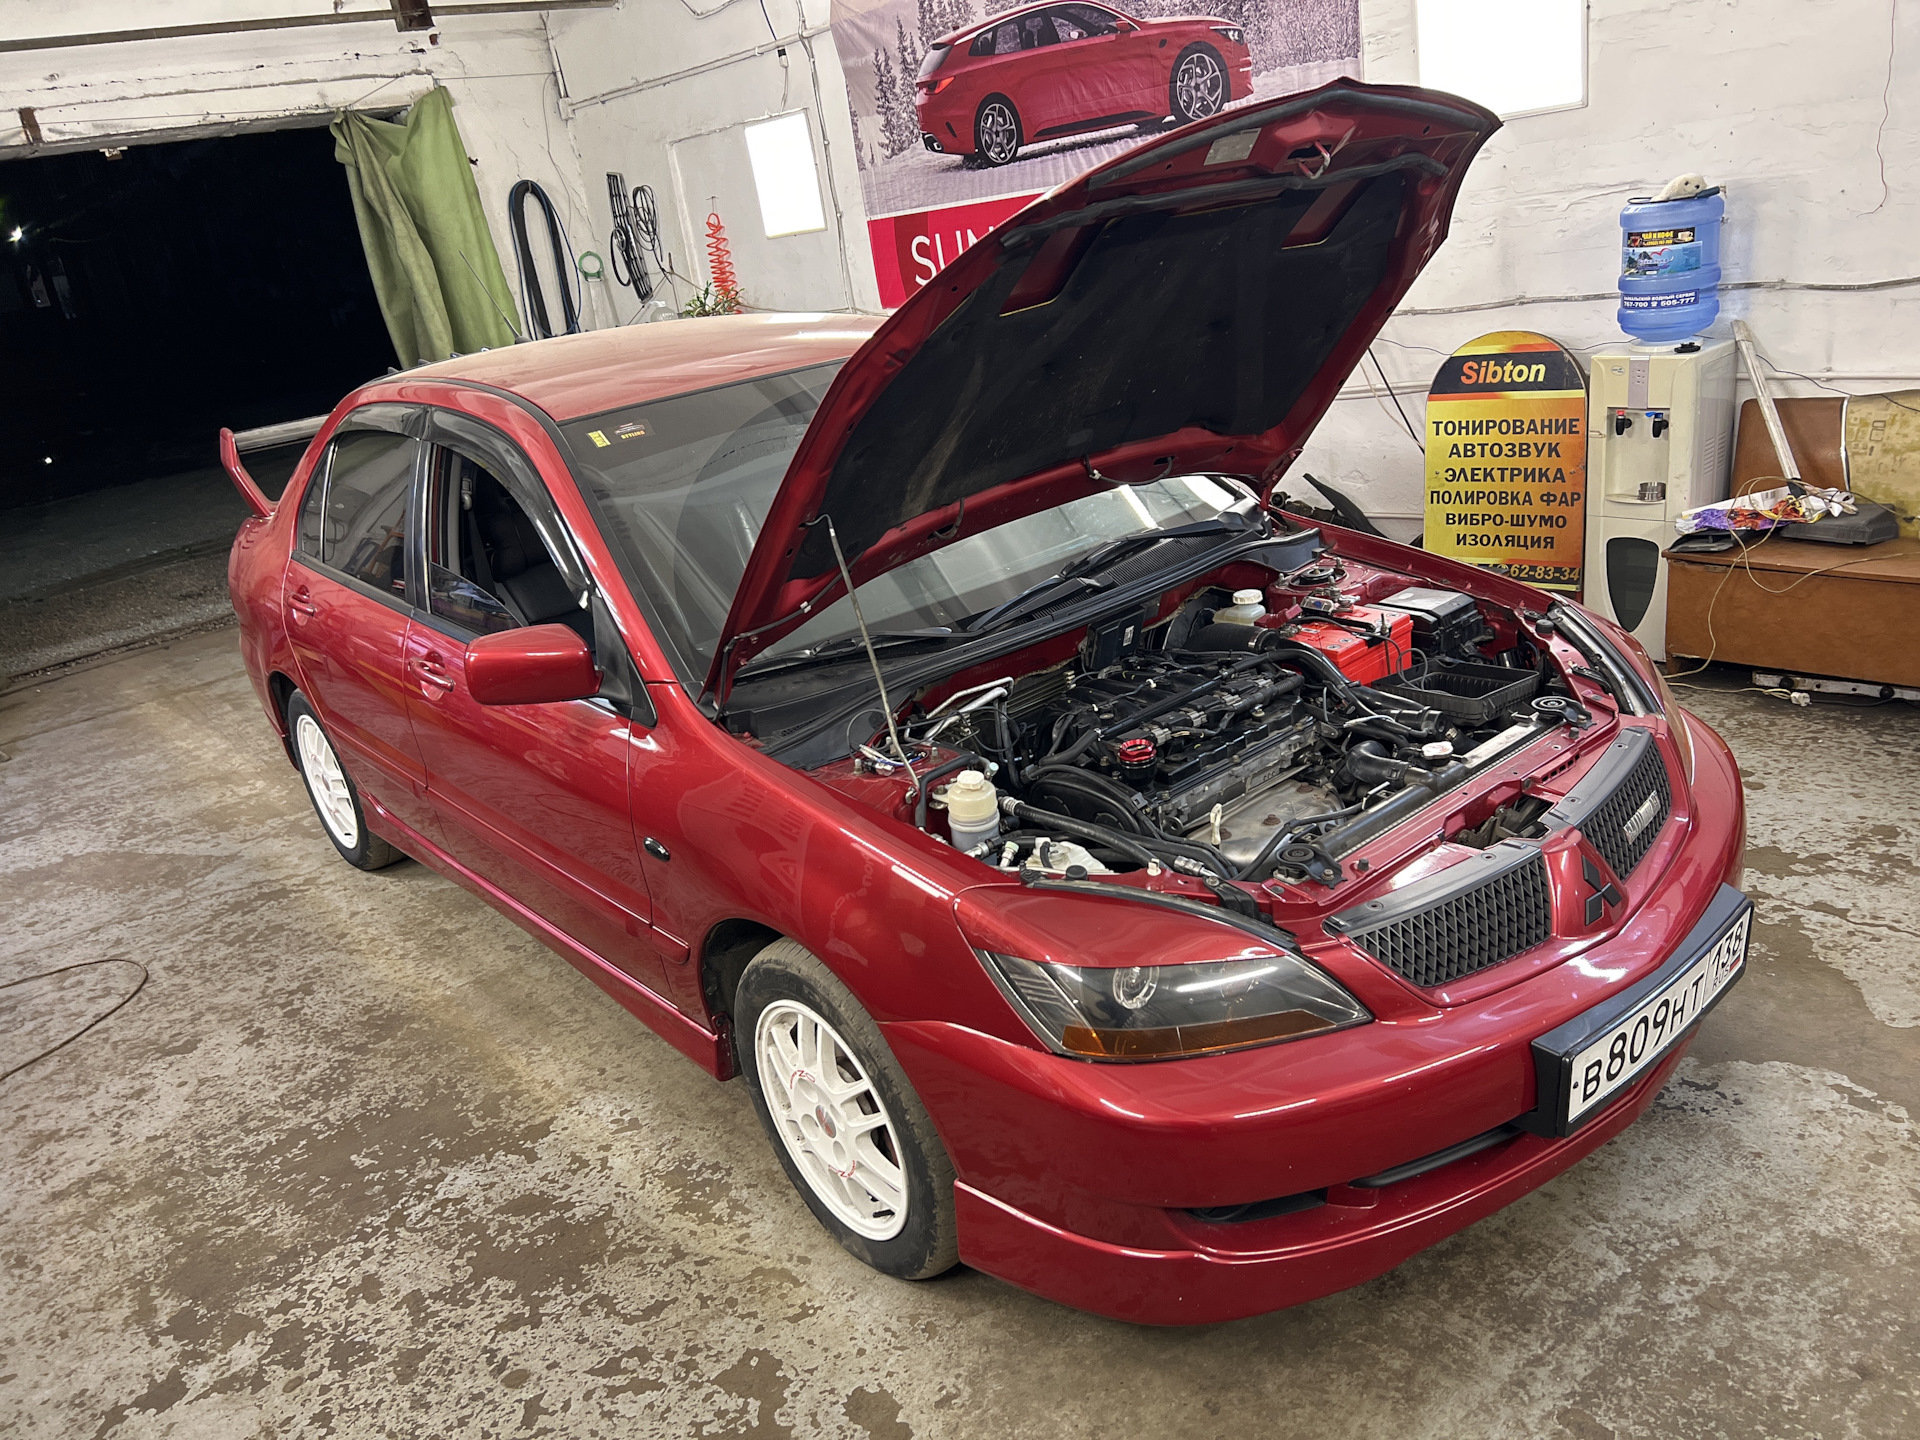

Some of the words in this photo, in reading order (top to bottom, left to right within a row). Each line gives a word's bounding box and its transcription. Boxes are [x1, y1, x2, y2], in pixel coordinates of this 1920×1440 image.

[1460, 360, 1546, 385] Sibton
[1432, 418, 1580, 436] ТОНИРОВАНИЕ
[1448, 442, 1561, 458] АВТОЗВУК
[1444, 467, 1566, 483] ЭЛЕКТРИКА
[1430, 490, 1533, 506] ПОЛИРОВКА
[1539, 491, 1582, 507] ФАР
[1445, 513, 1567, 528] ВИБРО-ШУМО
[1456, 533, 1554, 550] ИЗОЛЯЦИЯ
[1711, 921, 1743, 977] 138
[1712, 965, 1730, 991] RUS
